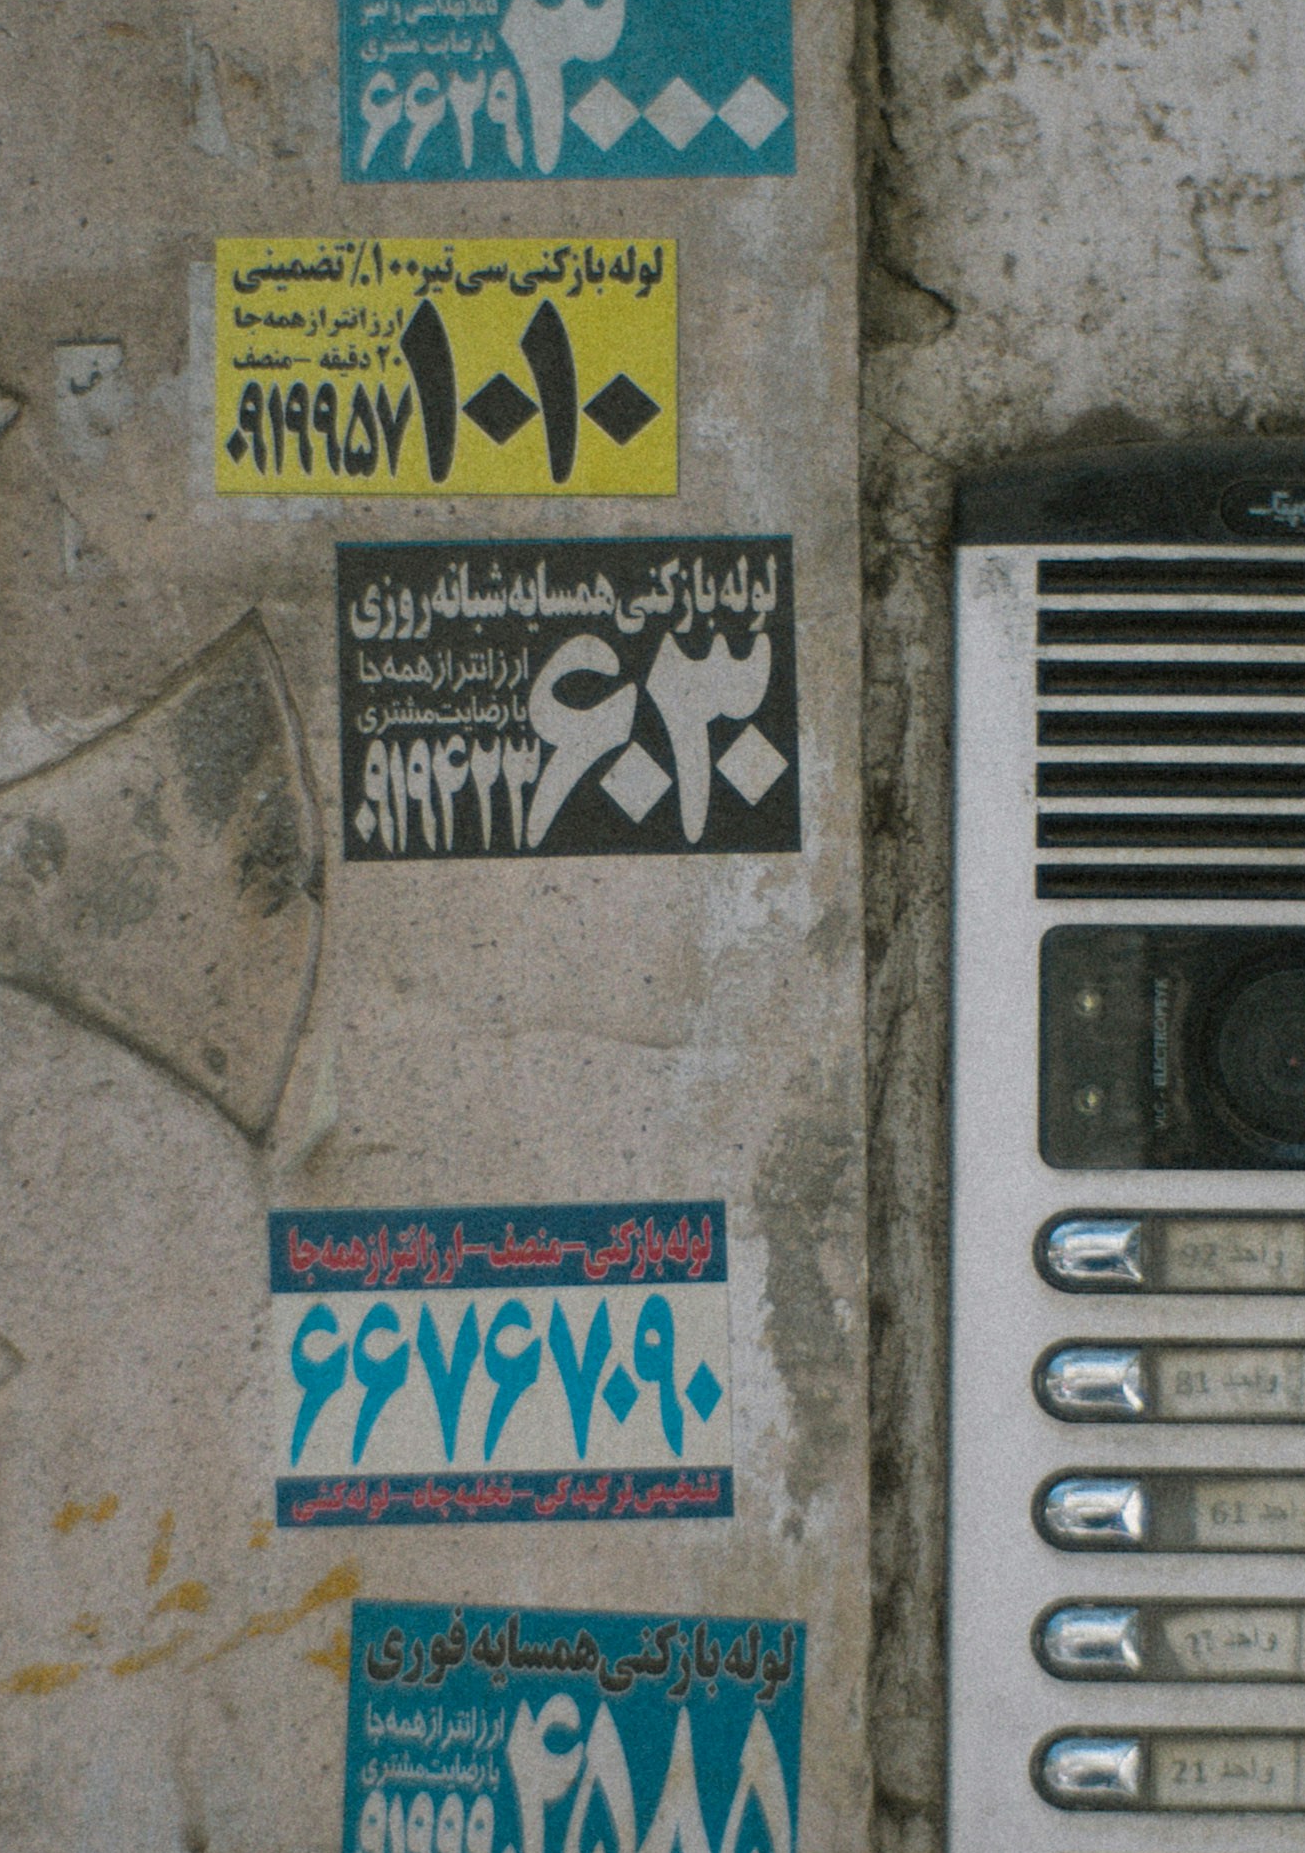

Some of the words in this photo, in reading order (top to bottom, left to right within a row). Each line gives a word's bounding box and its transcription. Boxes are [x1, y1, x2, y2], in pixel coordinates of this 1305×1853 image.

[232, 243, 345, 294] تضمینی
[413, 246, 455, 297] تیر
[455, 264, 510, 297] سی
[509, 245, 605, 297] بازکنی
[608, 245, 663, 298] لوله
[233, 306, 263, 336] جا
[262, 311, 306, 331] همه
[304, 307, 327, 337] از
[327, 308, 404, 338] ارزانتر
[319, 344, 372, 379] دقیقه
[350, 574, 433, 639] روزی
[432, 562, 508, 634] شبانه
[510, 559, 615, 632] همسایه
[615, 557, 716, 634] بازکنی
[719, 554, 776, 632] لوله
[357, 649, 384, 692] جا
[383, 653, 434, 683] همه
[432, 648, 454, 690] از
[453, 646, 529, 692] ارزانتر
[357, 696, 436, 735] مشتری
[434, 695, 513, 732] رضایت
[584, 1217, 667, 1280] بازکنی
[666, 1215, 712, 1279] لوله
[290, 1293, 724, 1468] ۶۶۷۶۷۰۹۰
[363, 1604, 469, 1687] فوری
[471, 1612, 600, 1692] همسایه
[596, 1620, 721, 1698] بازکنی
[723, 1620, 795, 1704] لوله
